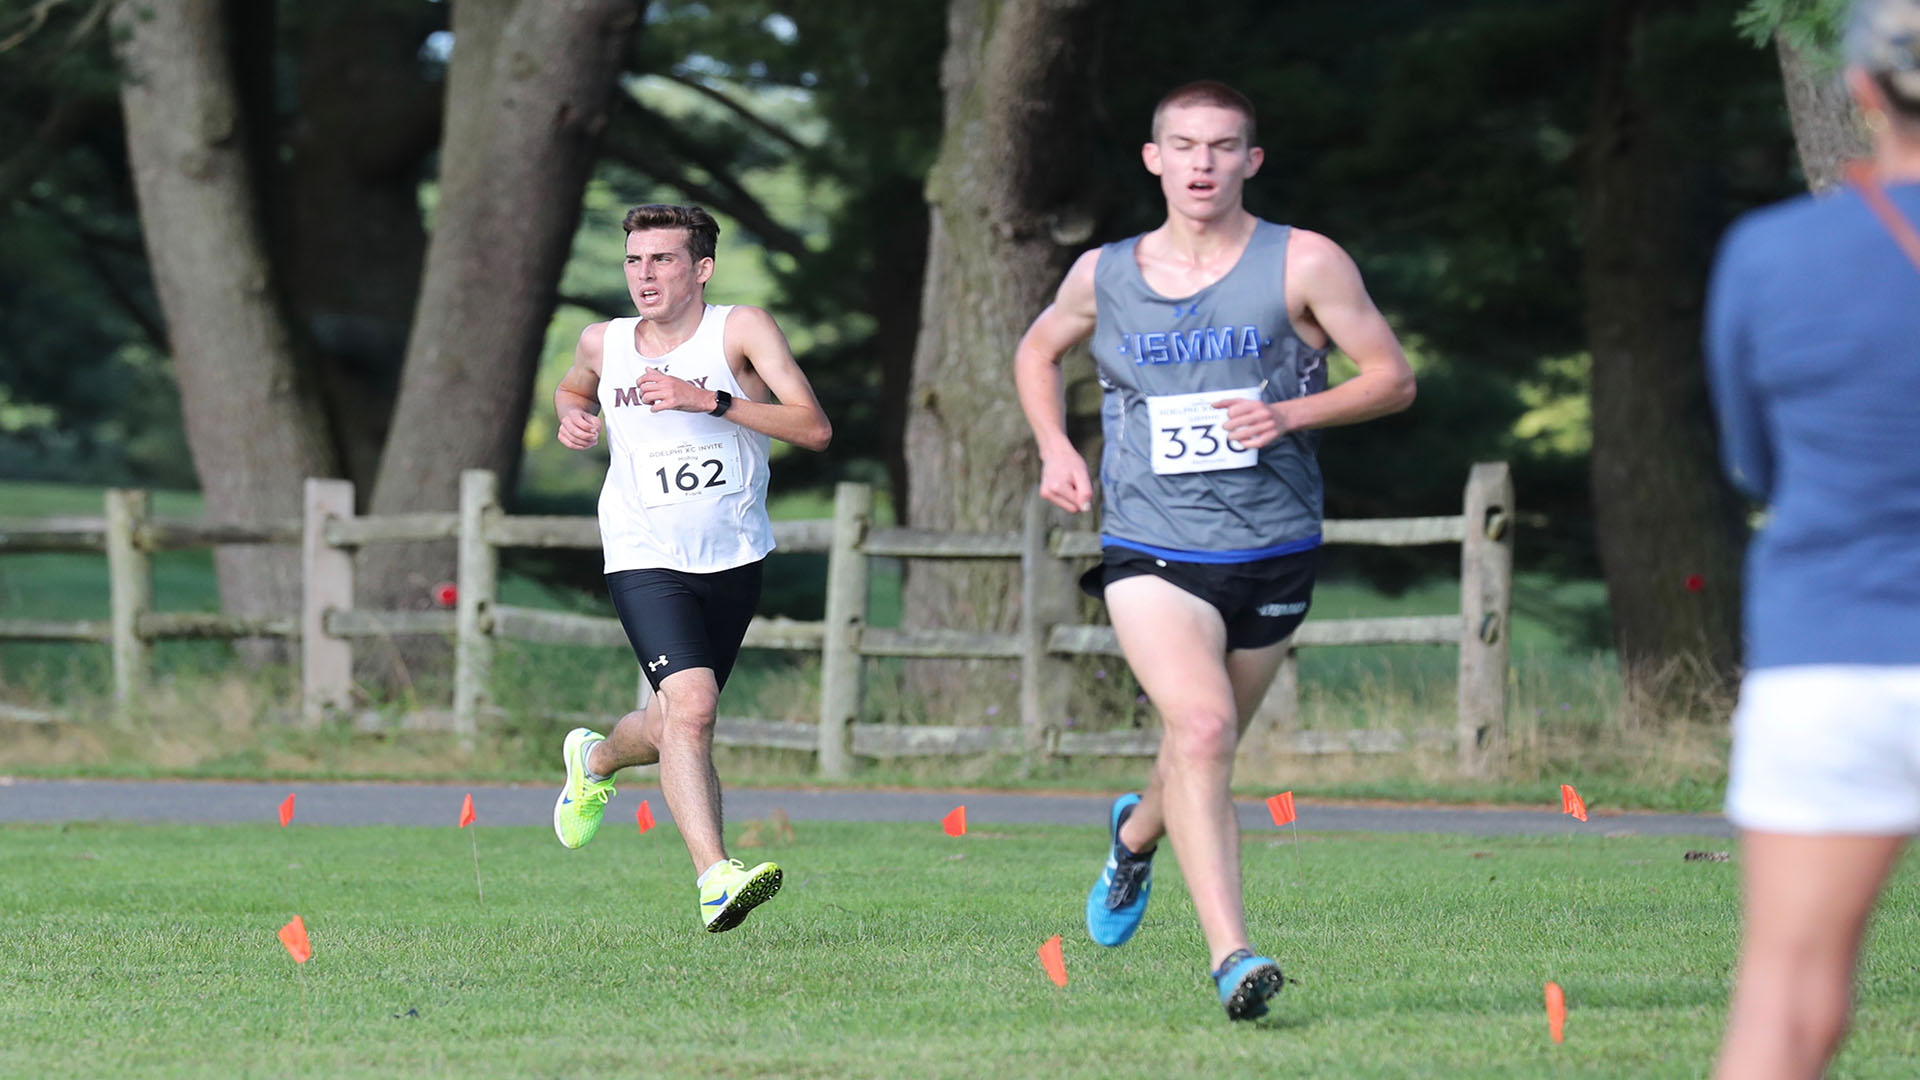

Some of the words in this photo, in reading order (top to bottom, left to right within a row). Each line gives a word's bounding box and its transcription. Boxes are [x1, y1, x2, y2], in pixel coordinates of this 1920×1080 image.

[648, 449, 683, 459] ADELPHI
[685, 446, 697, 454] XC
[699, 442, 724, 452] INVITE
[655, 458, 727, 494] 162
